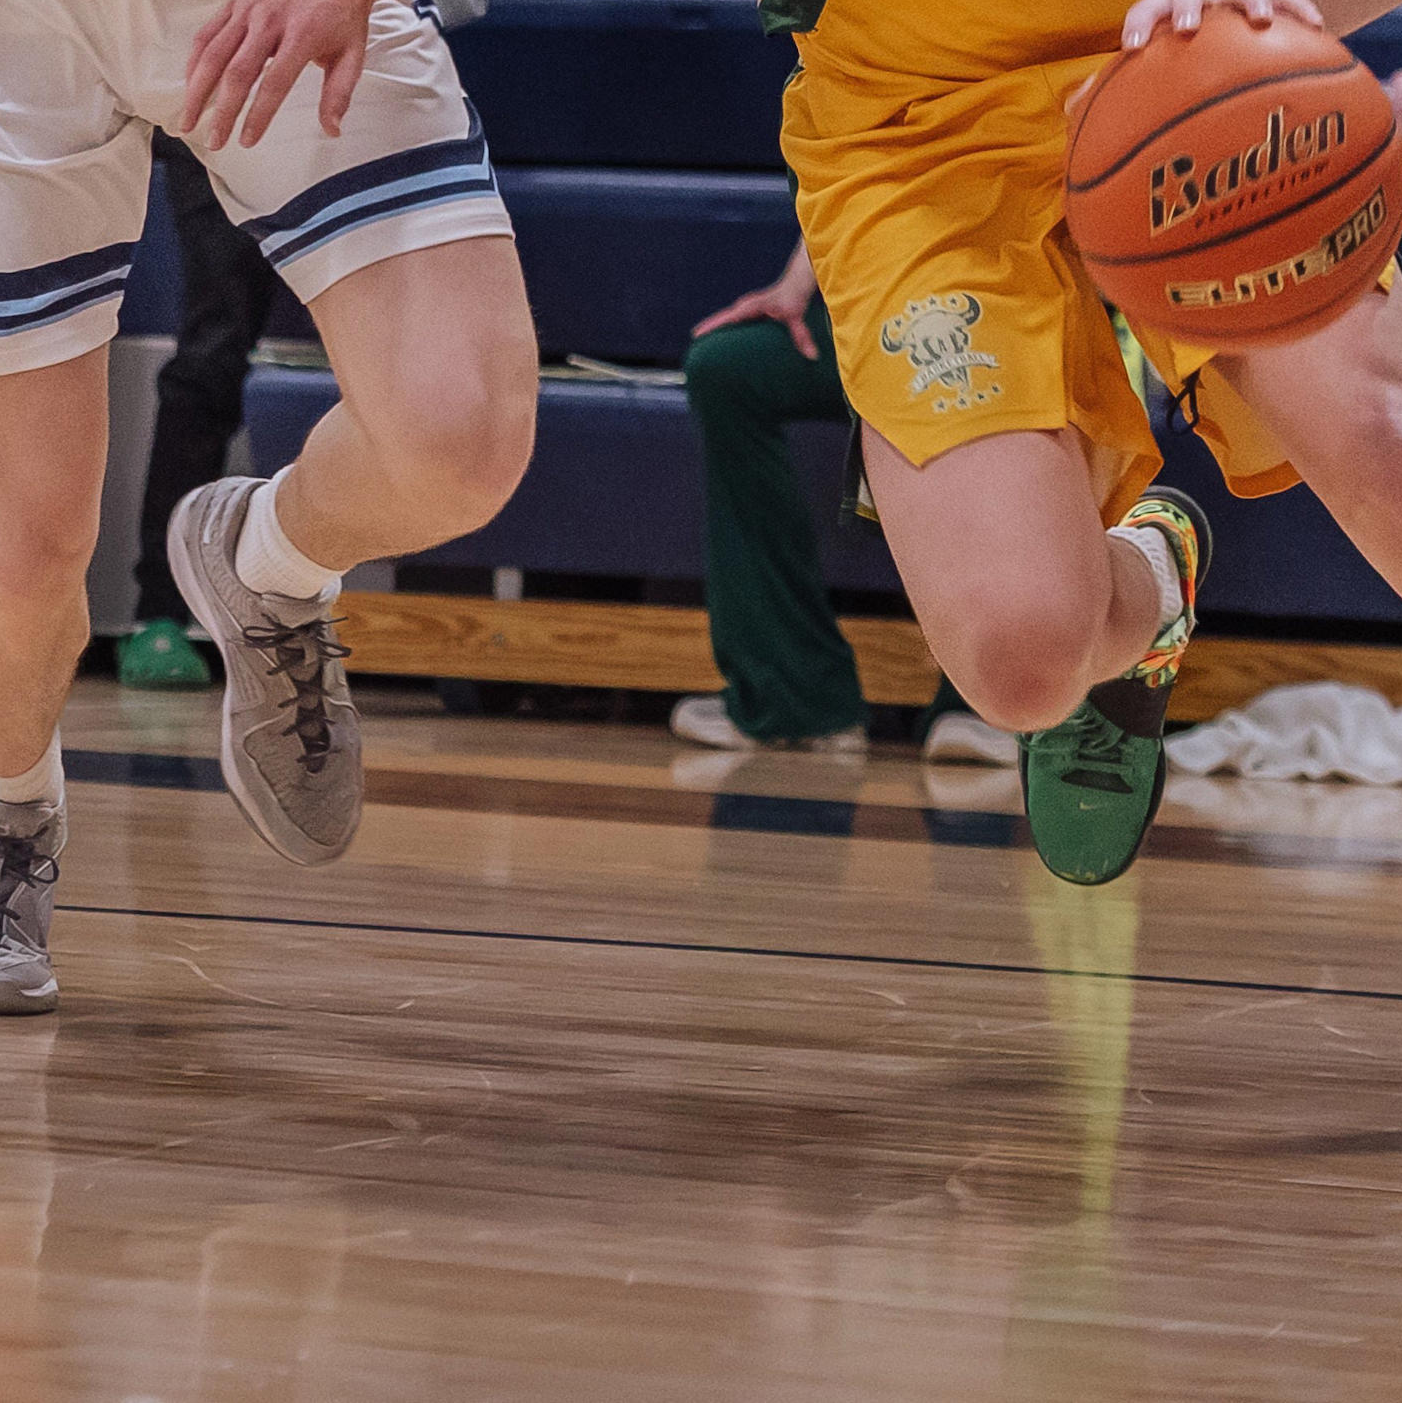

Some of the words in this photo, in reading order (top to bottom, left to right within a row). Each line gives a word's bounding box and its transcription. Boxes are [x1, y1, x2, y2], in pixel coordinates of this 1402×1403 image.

[1150, 105, 1346, 237] Baden
[1165, 248, 1327, 309] ELITE
[1331, 188, 1388, 265] PRO
